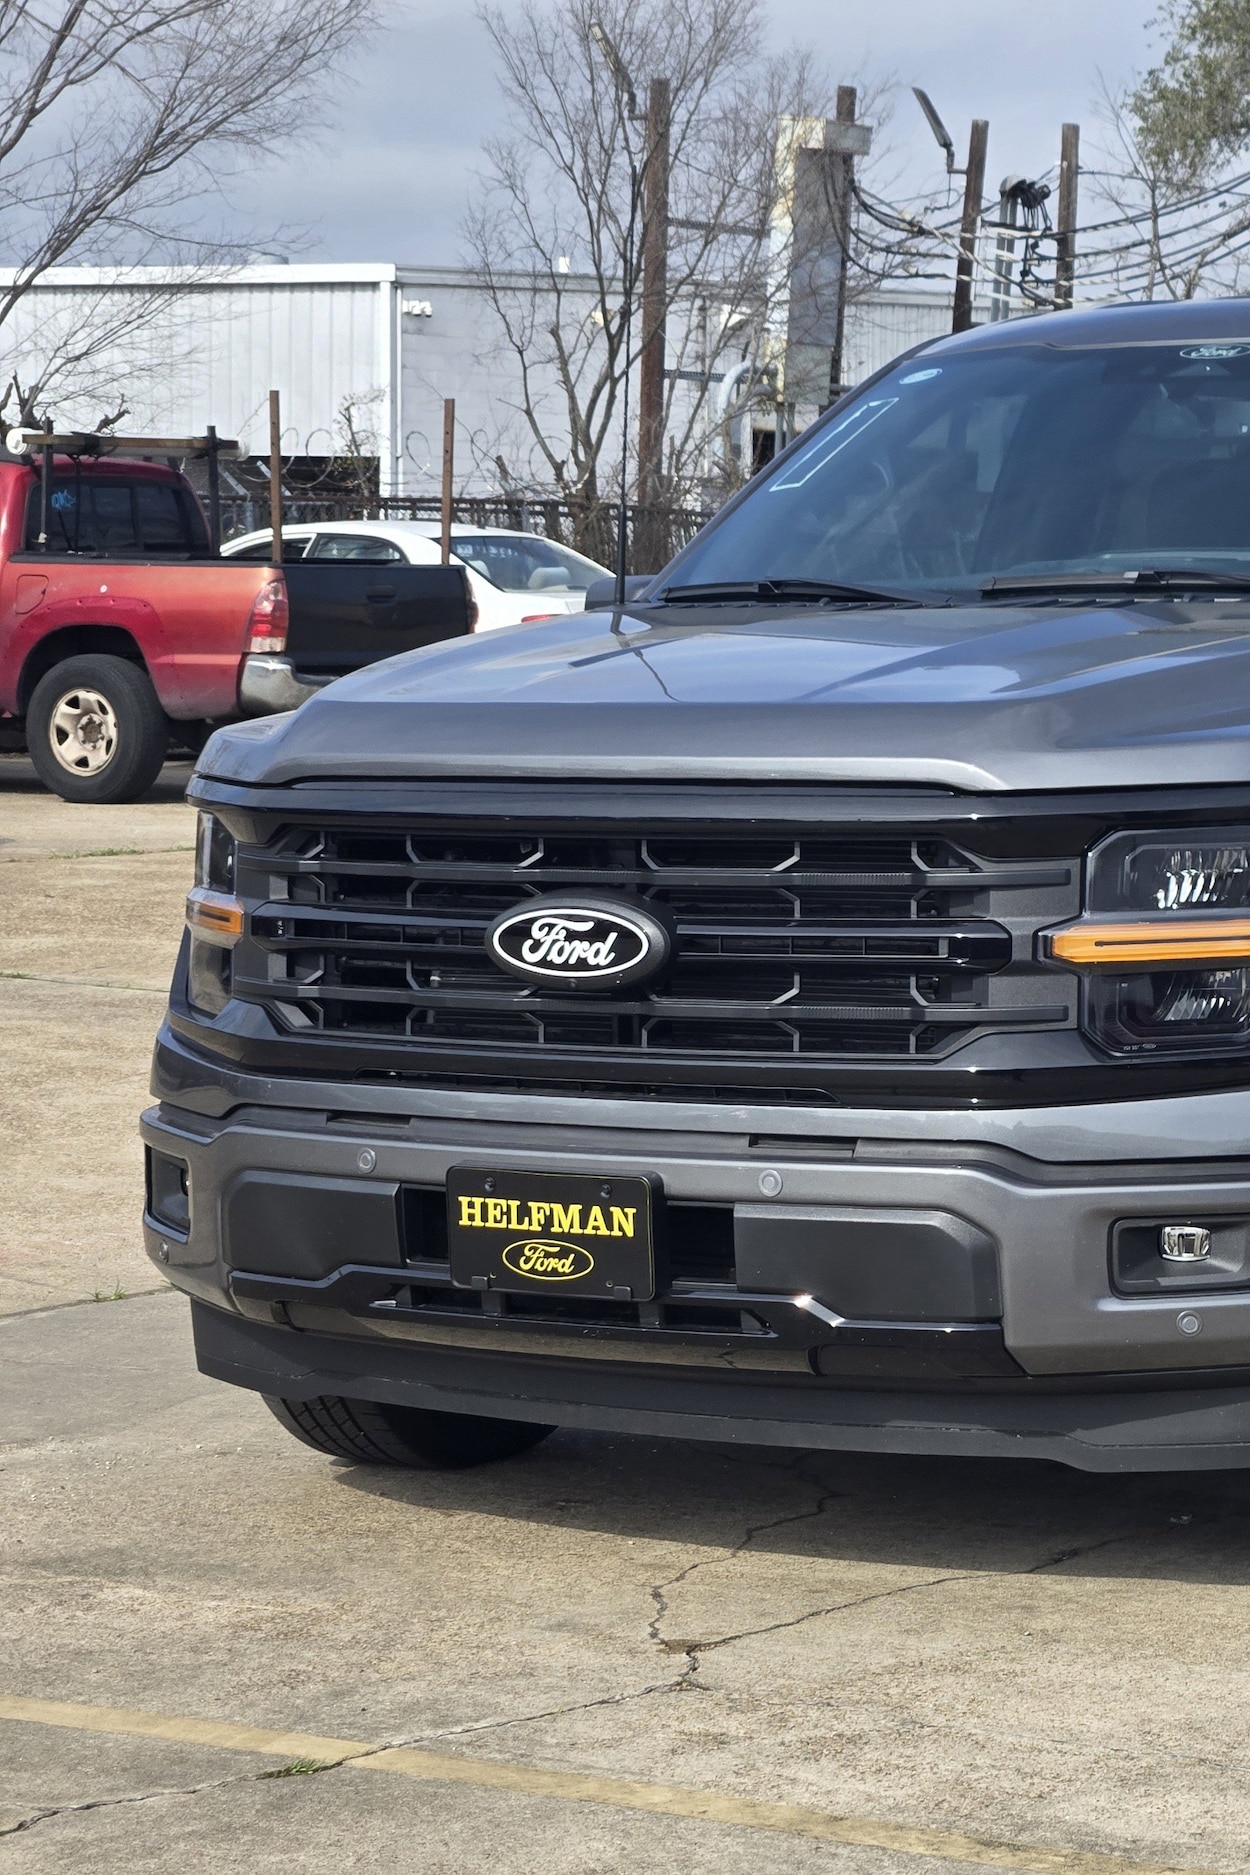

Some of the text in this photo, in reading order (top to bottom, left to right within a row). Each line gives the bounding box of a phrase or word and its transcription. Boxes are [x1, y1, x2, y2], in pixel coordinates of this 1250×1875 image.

[522, 917, 618, 966] Ford
[458, 1196, 637, 1238] HELFMAN
[519, 1243, 575, 1274] Ford
